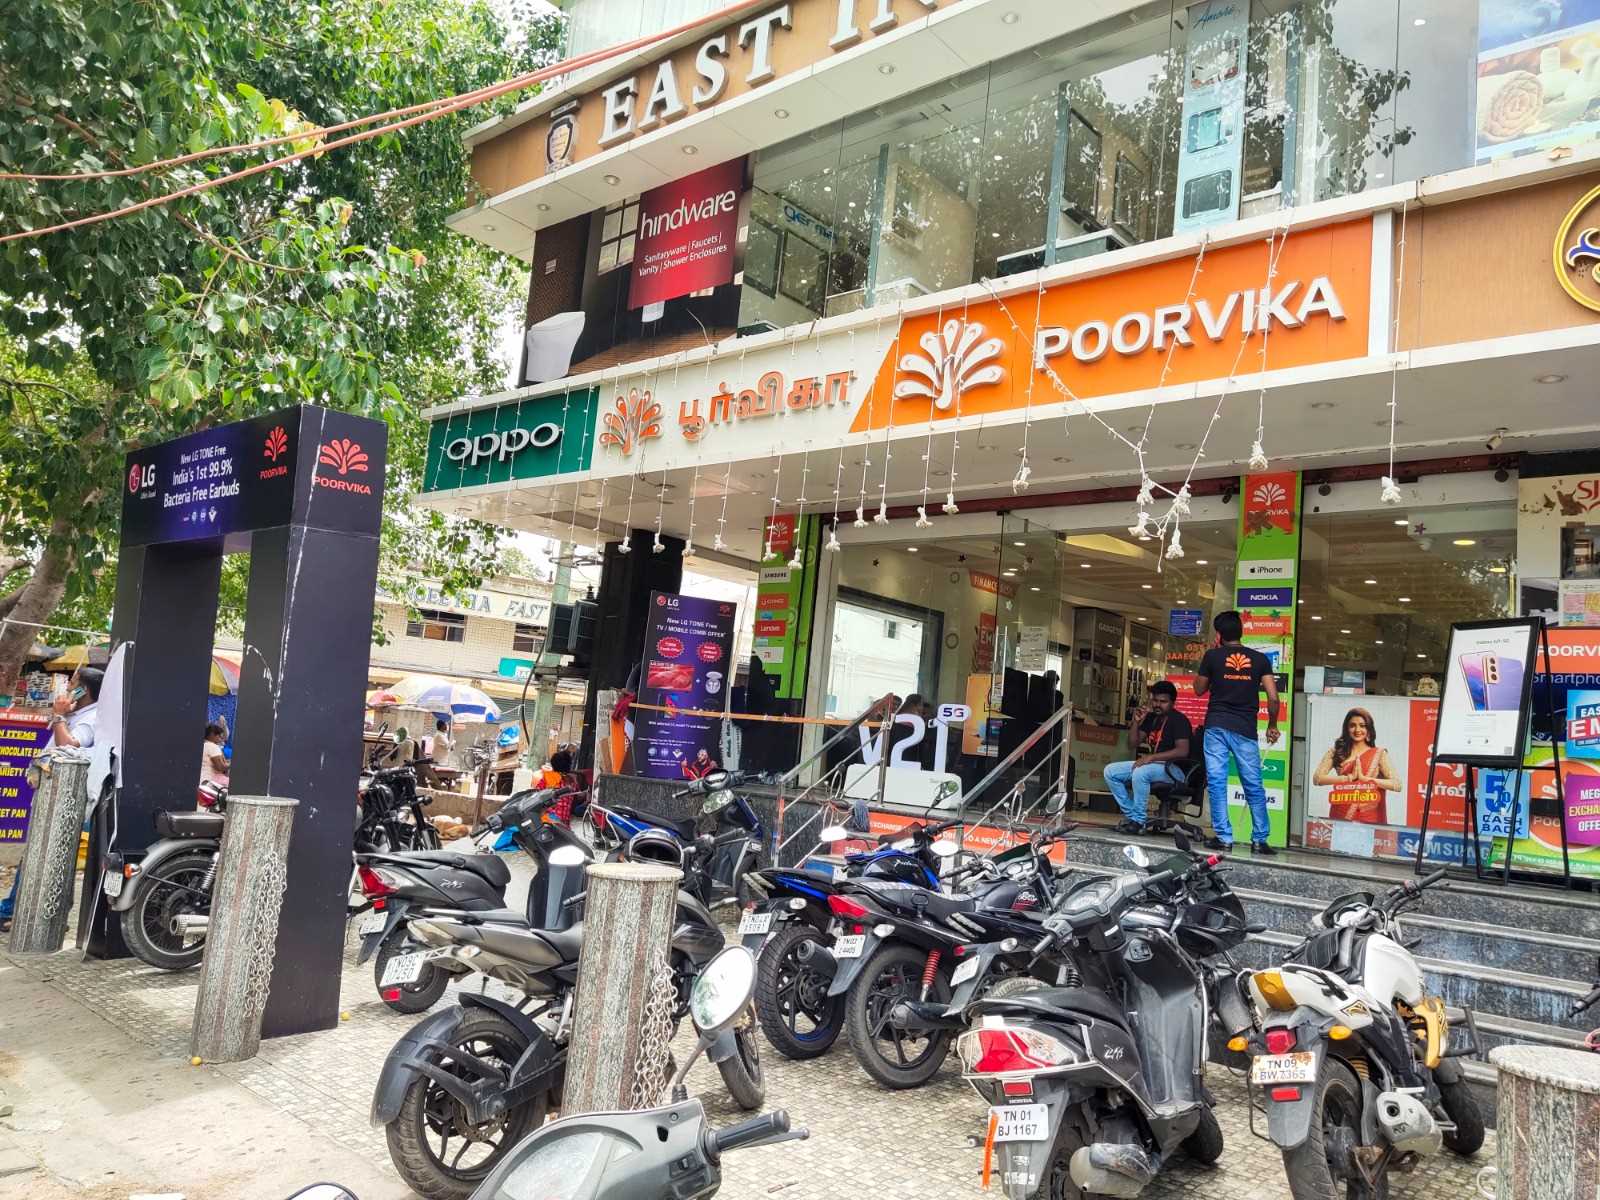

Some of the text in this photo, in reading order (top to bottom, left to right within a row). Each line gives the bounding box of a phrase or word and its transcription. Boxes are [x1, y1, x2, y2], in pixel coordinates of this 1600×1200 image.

[598, 4, 793, 149] EAST
[640, 190, 736, 240] hindware
[639, 244, 727, 277] Vanity Shower Enclosures
[644, 235, 719, 264] Sanitaryware Faucets
[1034, 274, 1347, 373] POORVIKA
[678, 370, 858, 443] பூர்விகா
[191, 450, 199, 462] LG
[199, 446, 213, 460] TONE
[214, 445, 227, 456] Free
[141, 463, 156, 488] LG
[172, 458, 233, 486] India's 1st 99.9%
[163, 478, 240, 508] Bacteria Free Earbuds
[312, 475, 372, 495] POORVIKA
[1257, 566, 1283, 574] iPhone
[504, 599, 548, 620] FAST
[667, 598, 679, 607] LG
[942, 707, 965, 718] 5G
[1267, 1058, 1297, 1069] TN 09
[1004, 1110, 1032, 1121] TN 01
[998, 1124, 1038, 1137] BJ 1167
